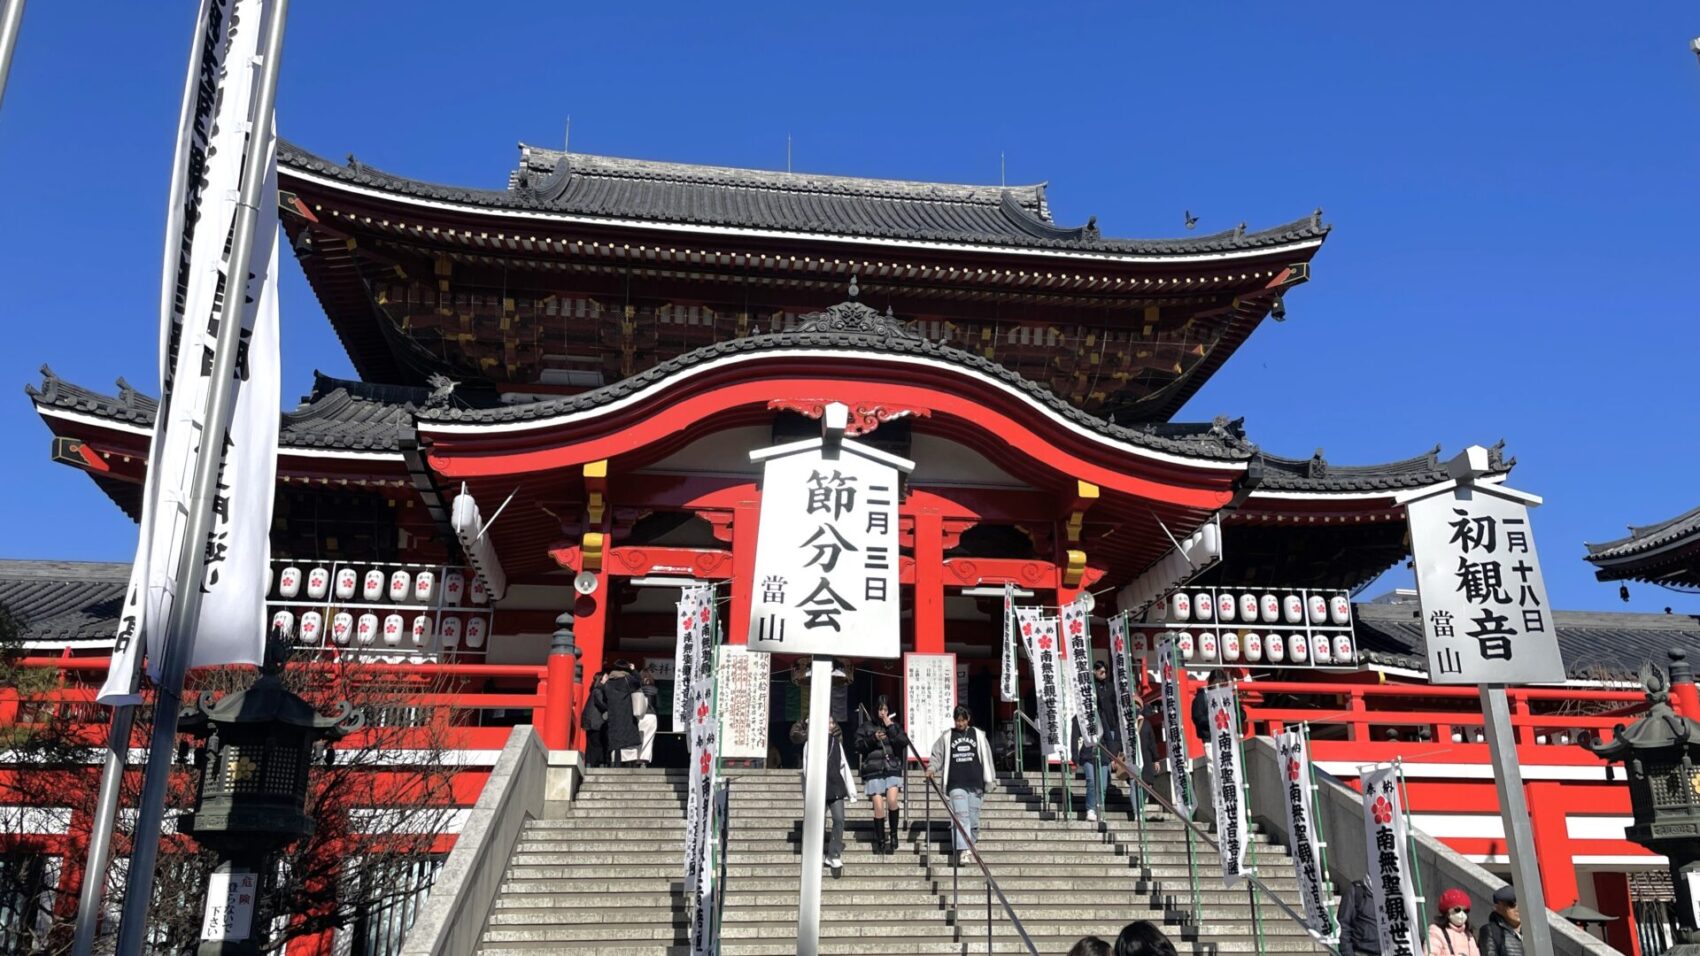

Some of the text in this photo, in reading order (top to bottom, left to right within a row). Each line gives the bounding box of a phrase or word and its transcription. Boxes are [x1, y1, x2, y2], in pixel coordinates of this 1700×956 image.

[795, 469, 859, 633] 節分会
[864, 485, 891, 602] 二月三日
[1448, 507, 1518, 661] 初観音
[1502, 518, 1545, 634] 一月十八日
[758, 574, 788, 643] 當山
[1430, 609, 1462, 674] 當山
[1217, 731, 1240, 876] 南無聖観世音菩薩
[1365, 780, 1394, 795] 奉納
